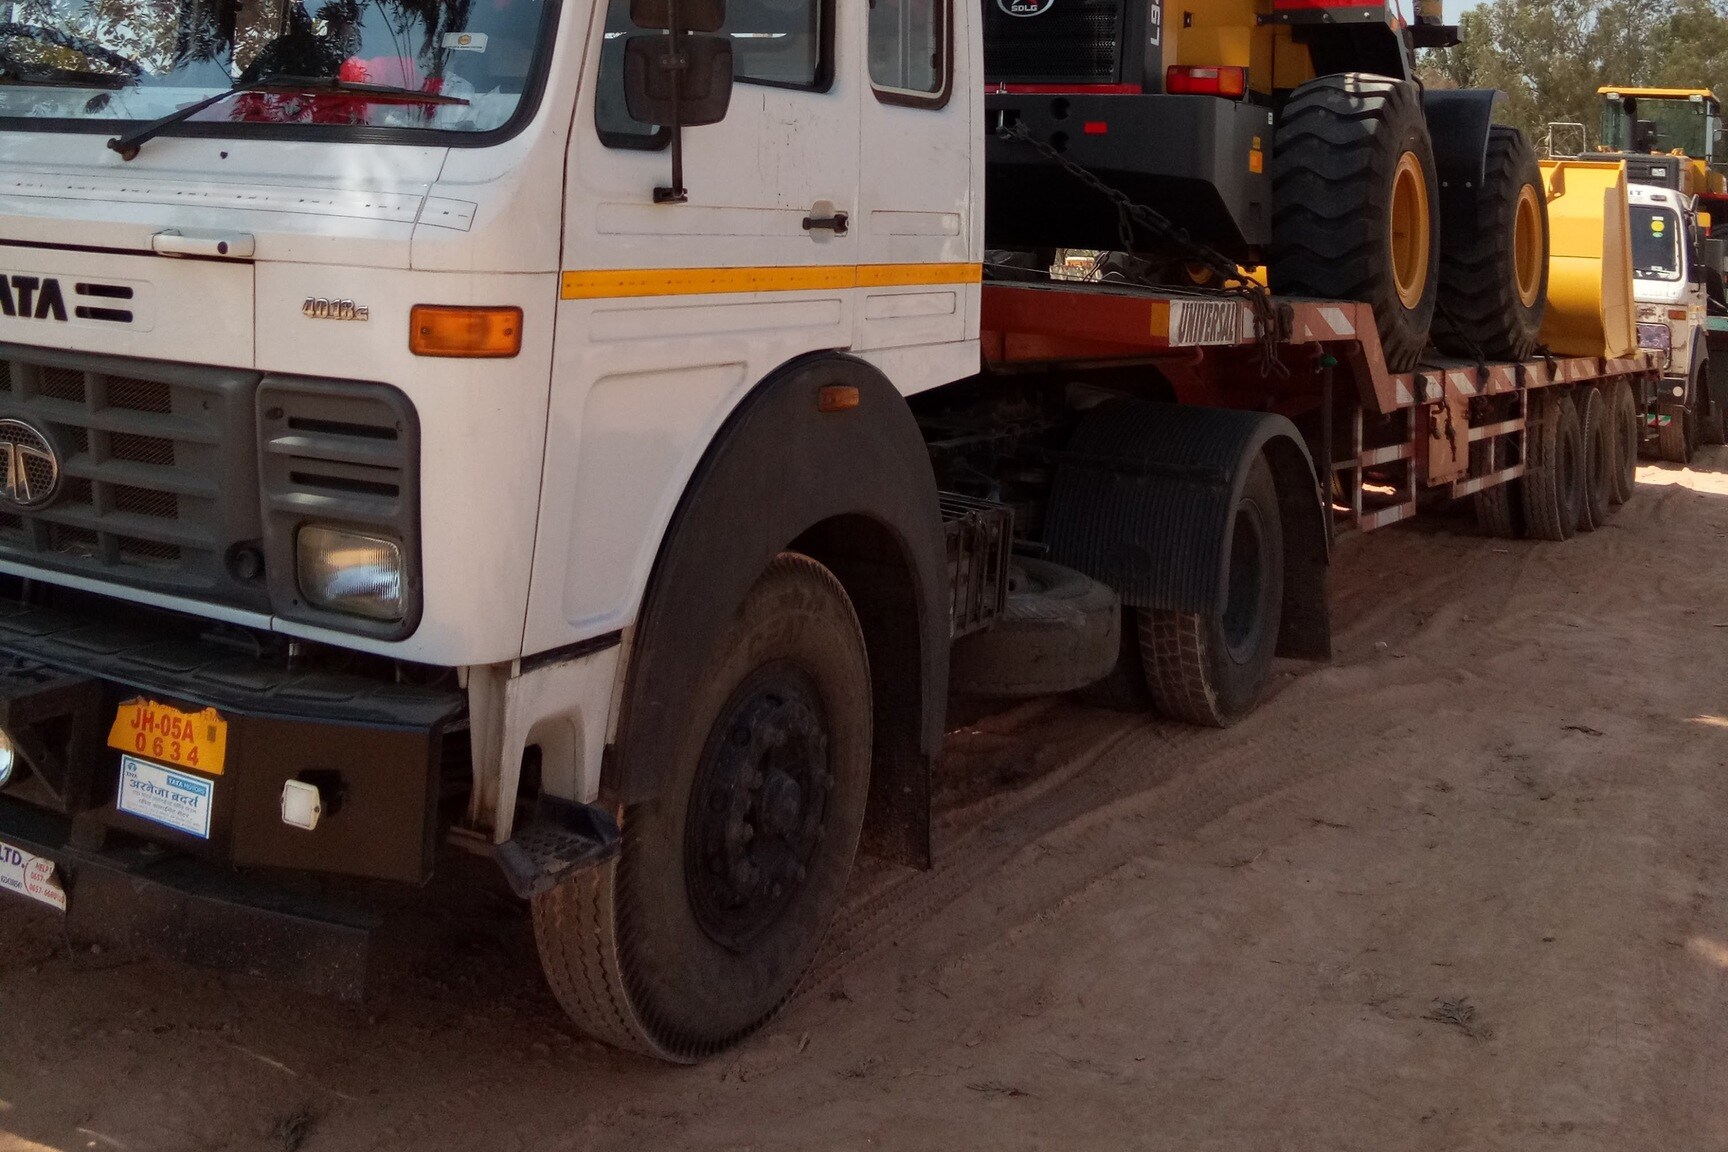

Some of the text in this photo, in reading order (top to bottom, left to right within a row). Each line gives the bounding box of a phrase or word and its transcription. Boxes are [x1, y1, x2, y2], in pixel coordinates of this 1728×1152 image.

[1011, 4, 1038, 12] SDLG
[1177, 302, 1236, 343] UNIVERSAL
[130, 707, 195, 744] JH-05A
